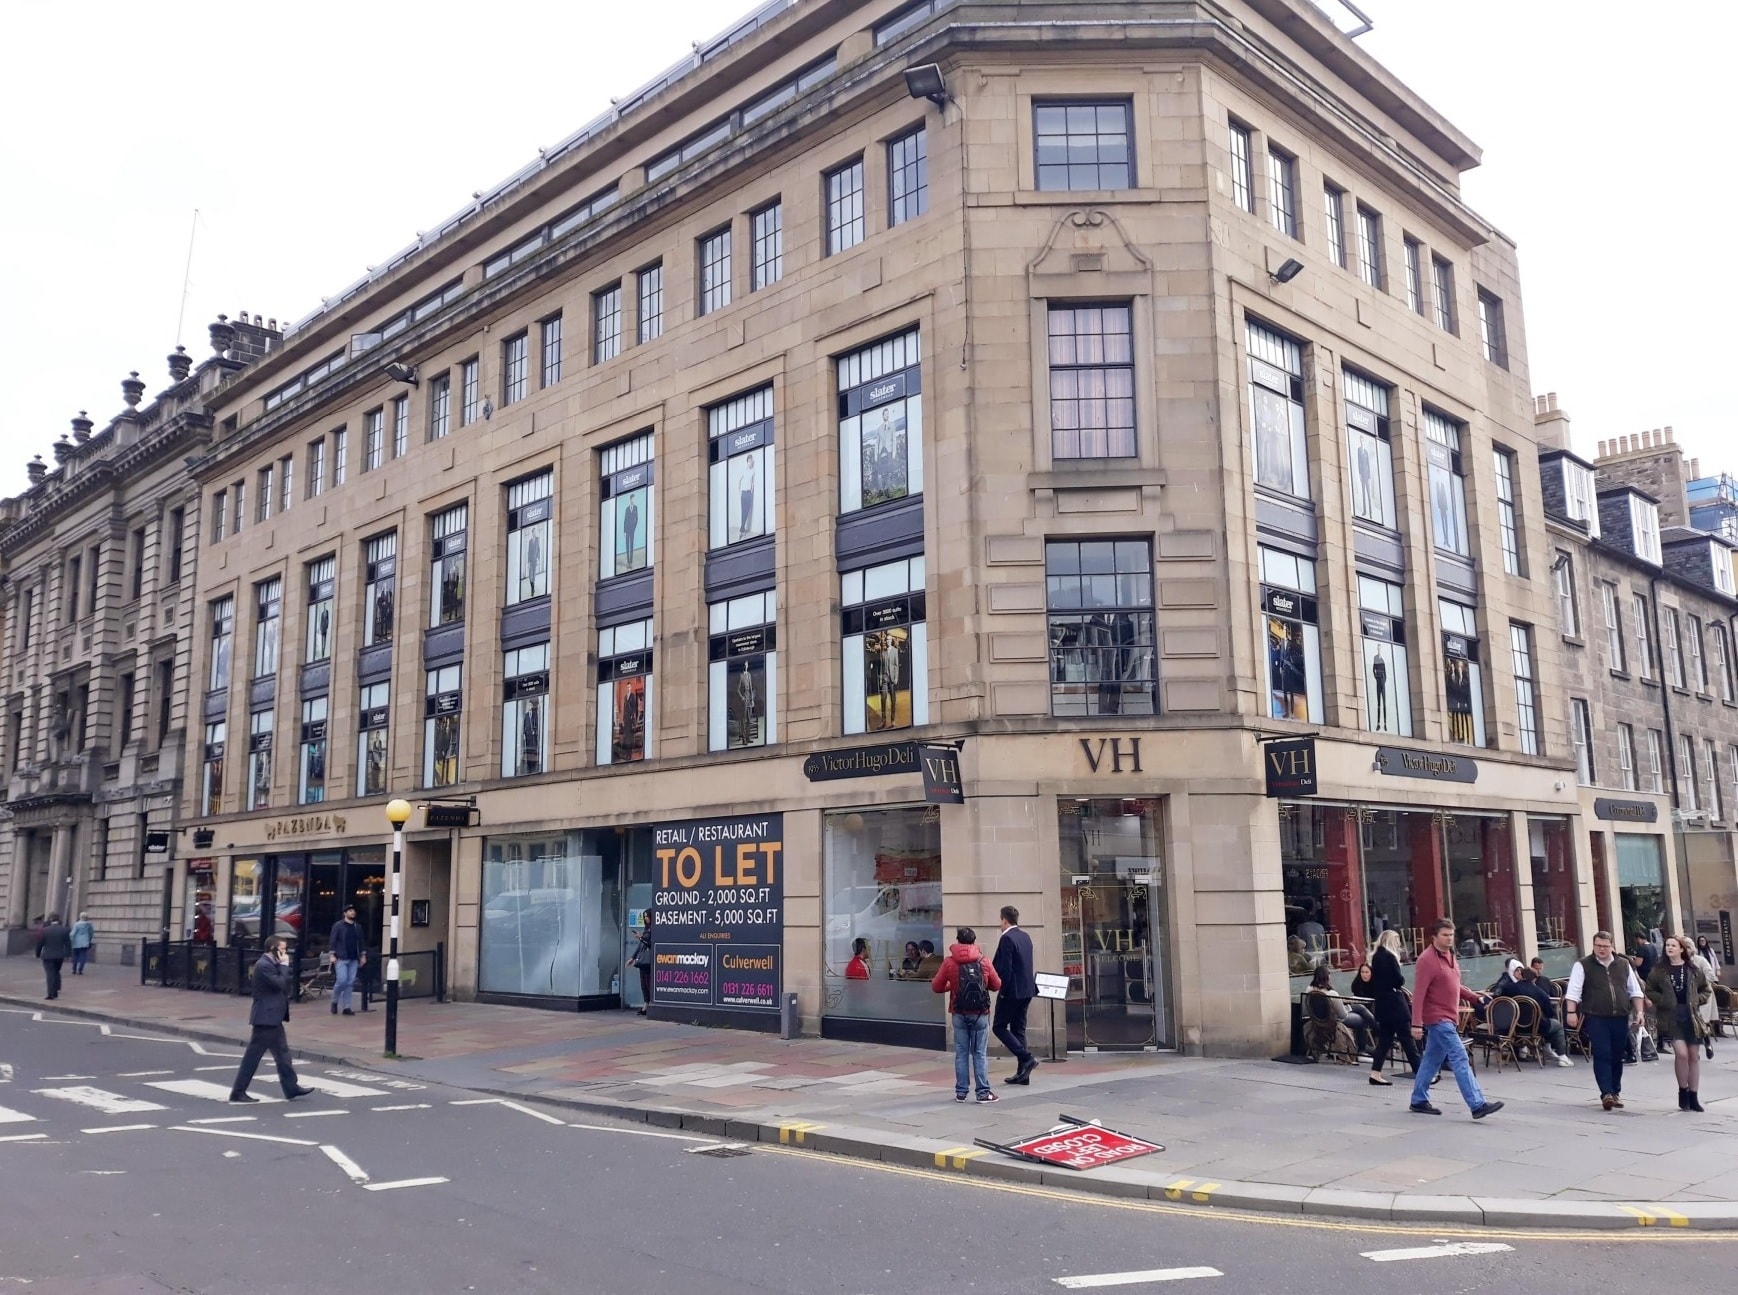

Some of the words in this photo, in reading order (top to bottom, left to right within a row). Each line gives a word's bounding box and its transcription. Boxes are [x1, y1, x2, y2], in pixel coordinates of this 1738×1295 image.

[869, 383, 896, 400] slater
[735, 432, 757, 447] slater
[622, 473, 641, 486] slater
[1273, 595, 1294, 610] slater
[620, 659, 640, 671] slater
[822, 753, 855, 772] Victor
[855, 751, 888, 772] Hugo
[888, 746, 914, 766] Deli
[1078, 737, 1143, 774] VH
[1269, 748, 1311, 776] VH
[925, 757, 957, 784] VH
[656, 829, 688, 845] RETAIL
[698, 821, 769, 842] RESTAURANT
[656, 846, 702, 888] TO
[715, 841, 782, 886] LET
[655, 890, 700, 906] GROUND
[707, 889, 737, 907] 2,000
[739, 887, 770, 904] SQ.FT
[655, 910, 707, 925] BASEMENT
[714, 909, 744, 927] 5,000
[747, 909, 778, 924] SQ.FT
[1094, 929, 1135, 953] VH
[656, 952, 709, 968] ewanmackay
[722, 954, 773, 970] Culverwell
[656, 970, 672, 983] 0141
[673, 971, 689, 984] 226
[690, 971, 709, 985] 1662
[722, 982, 739, 995] 0131
[741, 983, 755, 996] 226
[757, 983, 773, 997] 6611
[1033, 1133, 1102, 1155] CLOSED
[1094, 1144, 1147, 1159] ROAD
